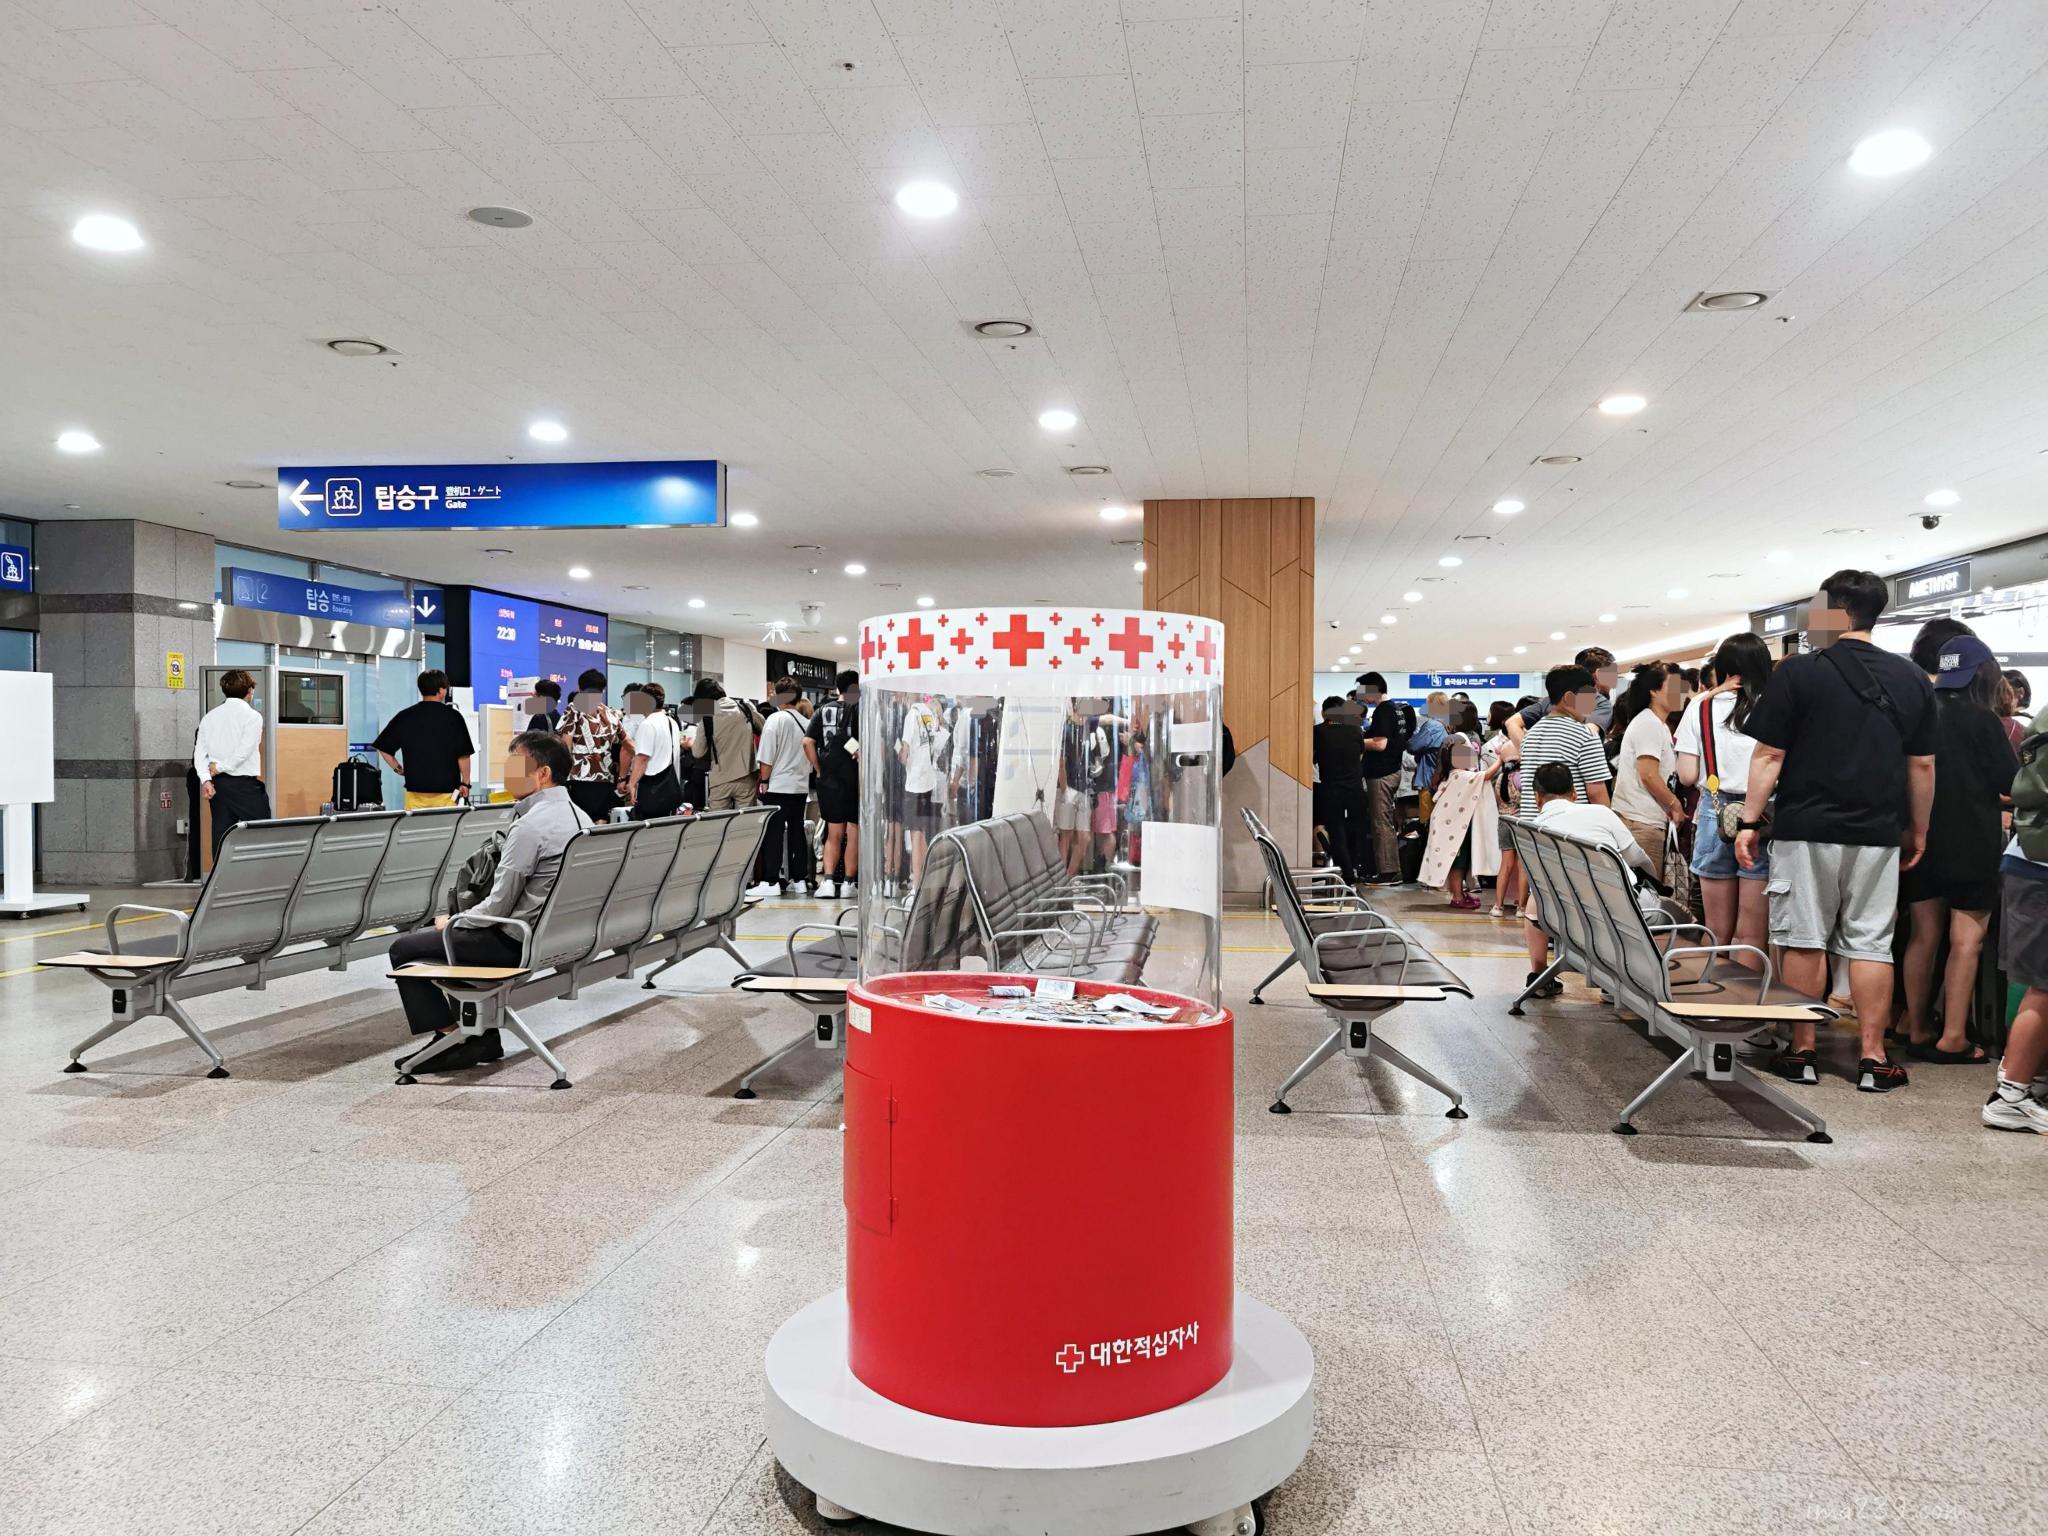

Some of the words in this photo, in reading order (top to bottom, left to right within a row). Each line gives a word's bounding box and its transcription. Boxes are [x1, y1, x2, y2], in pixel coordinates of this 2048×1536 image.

[375, 485, 439, 511] 탑승구
[445, 500, 467, 509] Gate
[306, 588, 330, 613] 탑승
[539, 633, 577, 648] ニューカメリア
[796, 662, 813, 677] COFFEE
[1090, 1320, 1200, 1367] 대한적십자사
